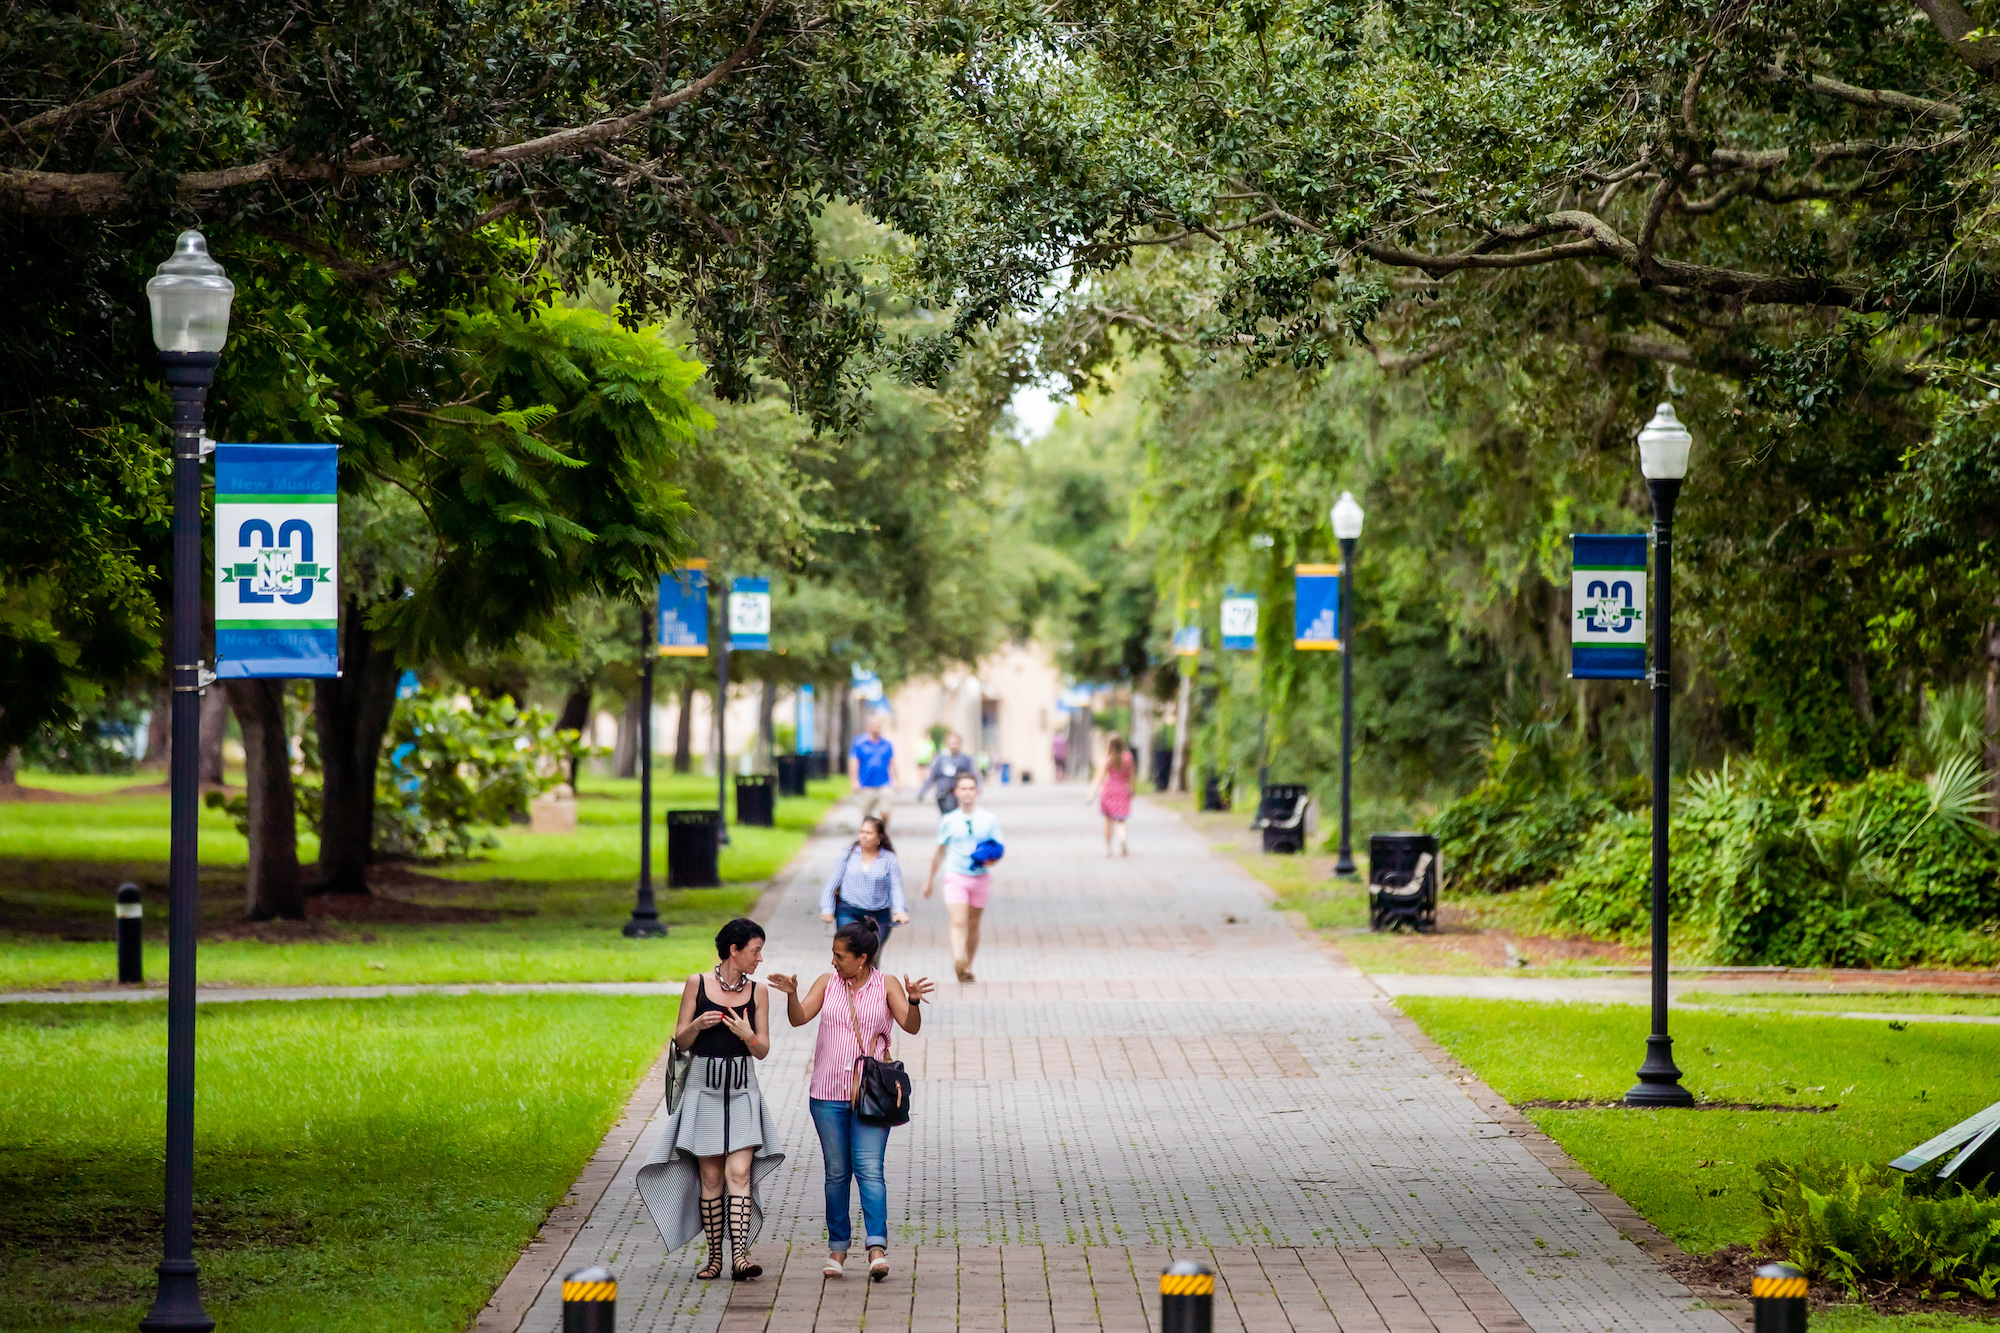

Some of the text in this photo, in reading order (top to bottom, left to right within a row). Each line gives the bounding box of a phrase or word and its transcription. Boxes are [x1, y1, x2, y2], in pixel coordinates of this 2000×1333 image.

[231, 478, 321, 490] New Music
[225, 633, 329, 648] New College
